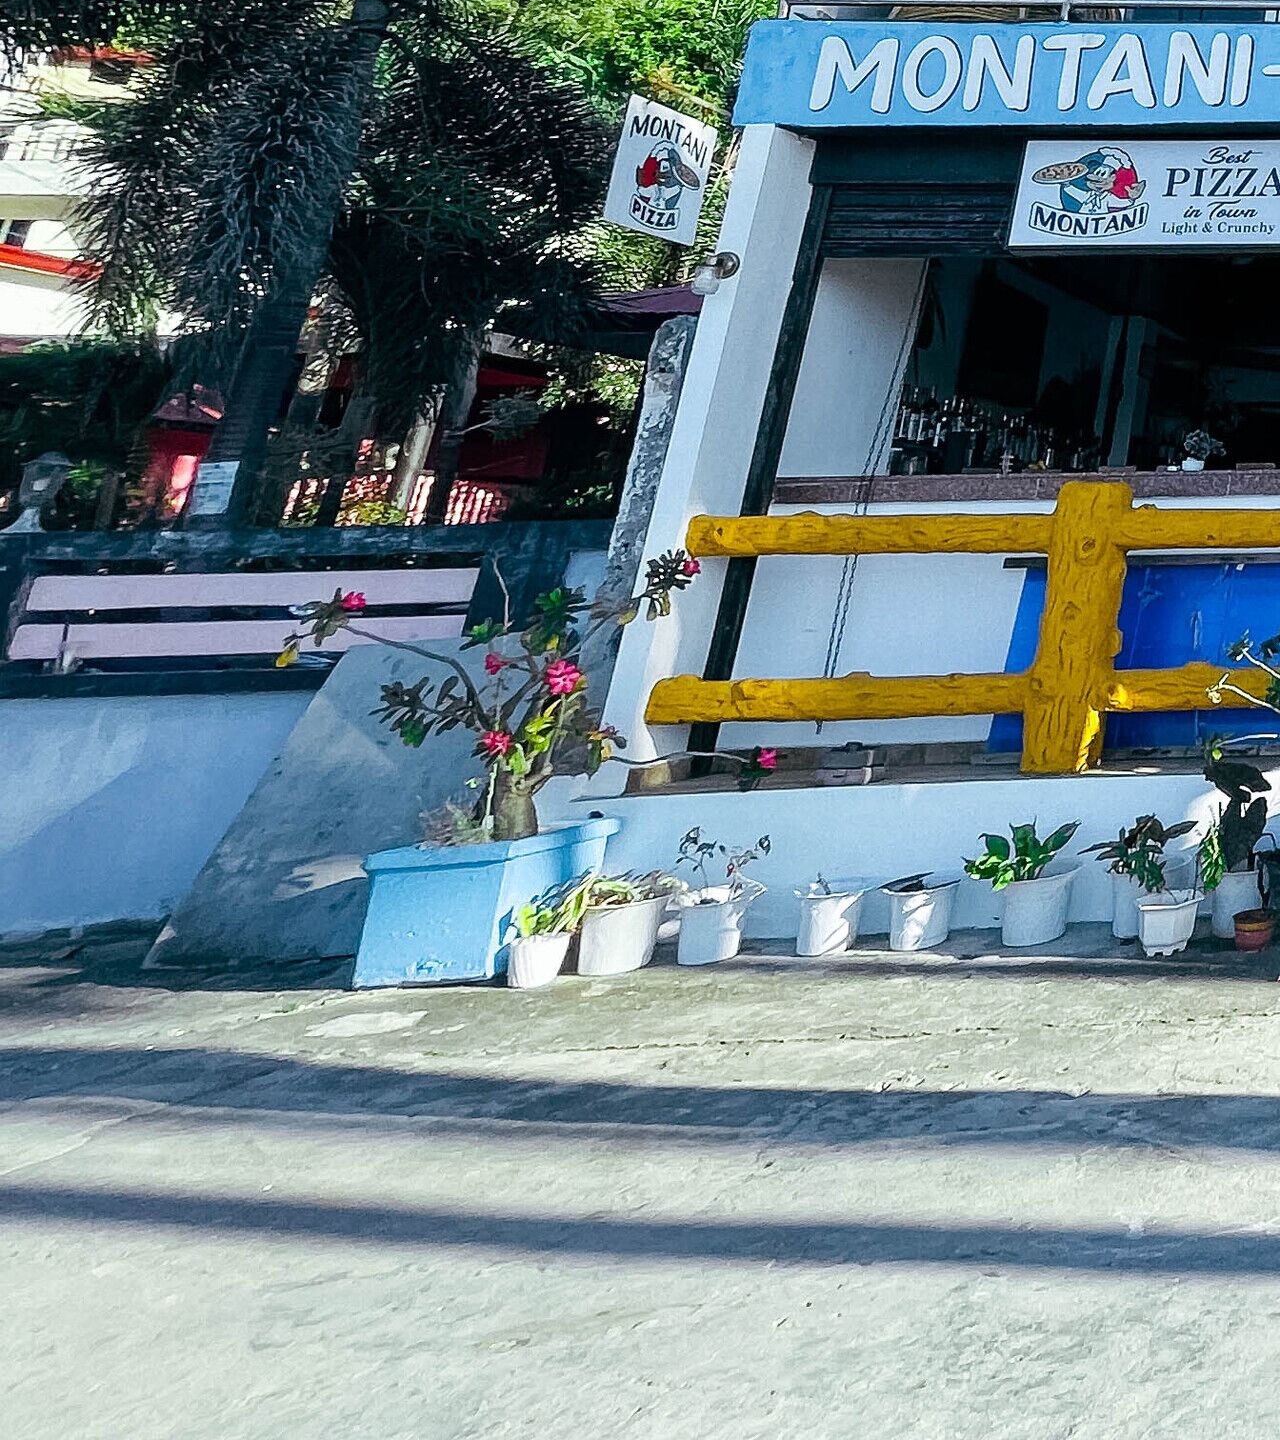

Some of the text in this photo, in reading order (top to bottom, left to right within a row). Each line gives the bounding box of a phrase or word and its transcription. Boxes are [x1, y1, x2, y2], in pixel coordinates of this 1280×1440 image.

[629, 114, 708, 169] MONTANI
[1202, 147, 1263, 165] Best
[631, 198, 676, 228] PIZZA
[1032, 205, 1147, 236] MONTANI
[1184, 198, 1258, 220] in Town
[1162, 222, 1276, 235] Light & Crunchy
